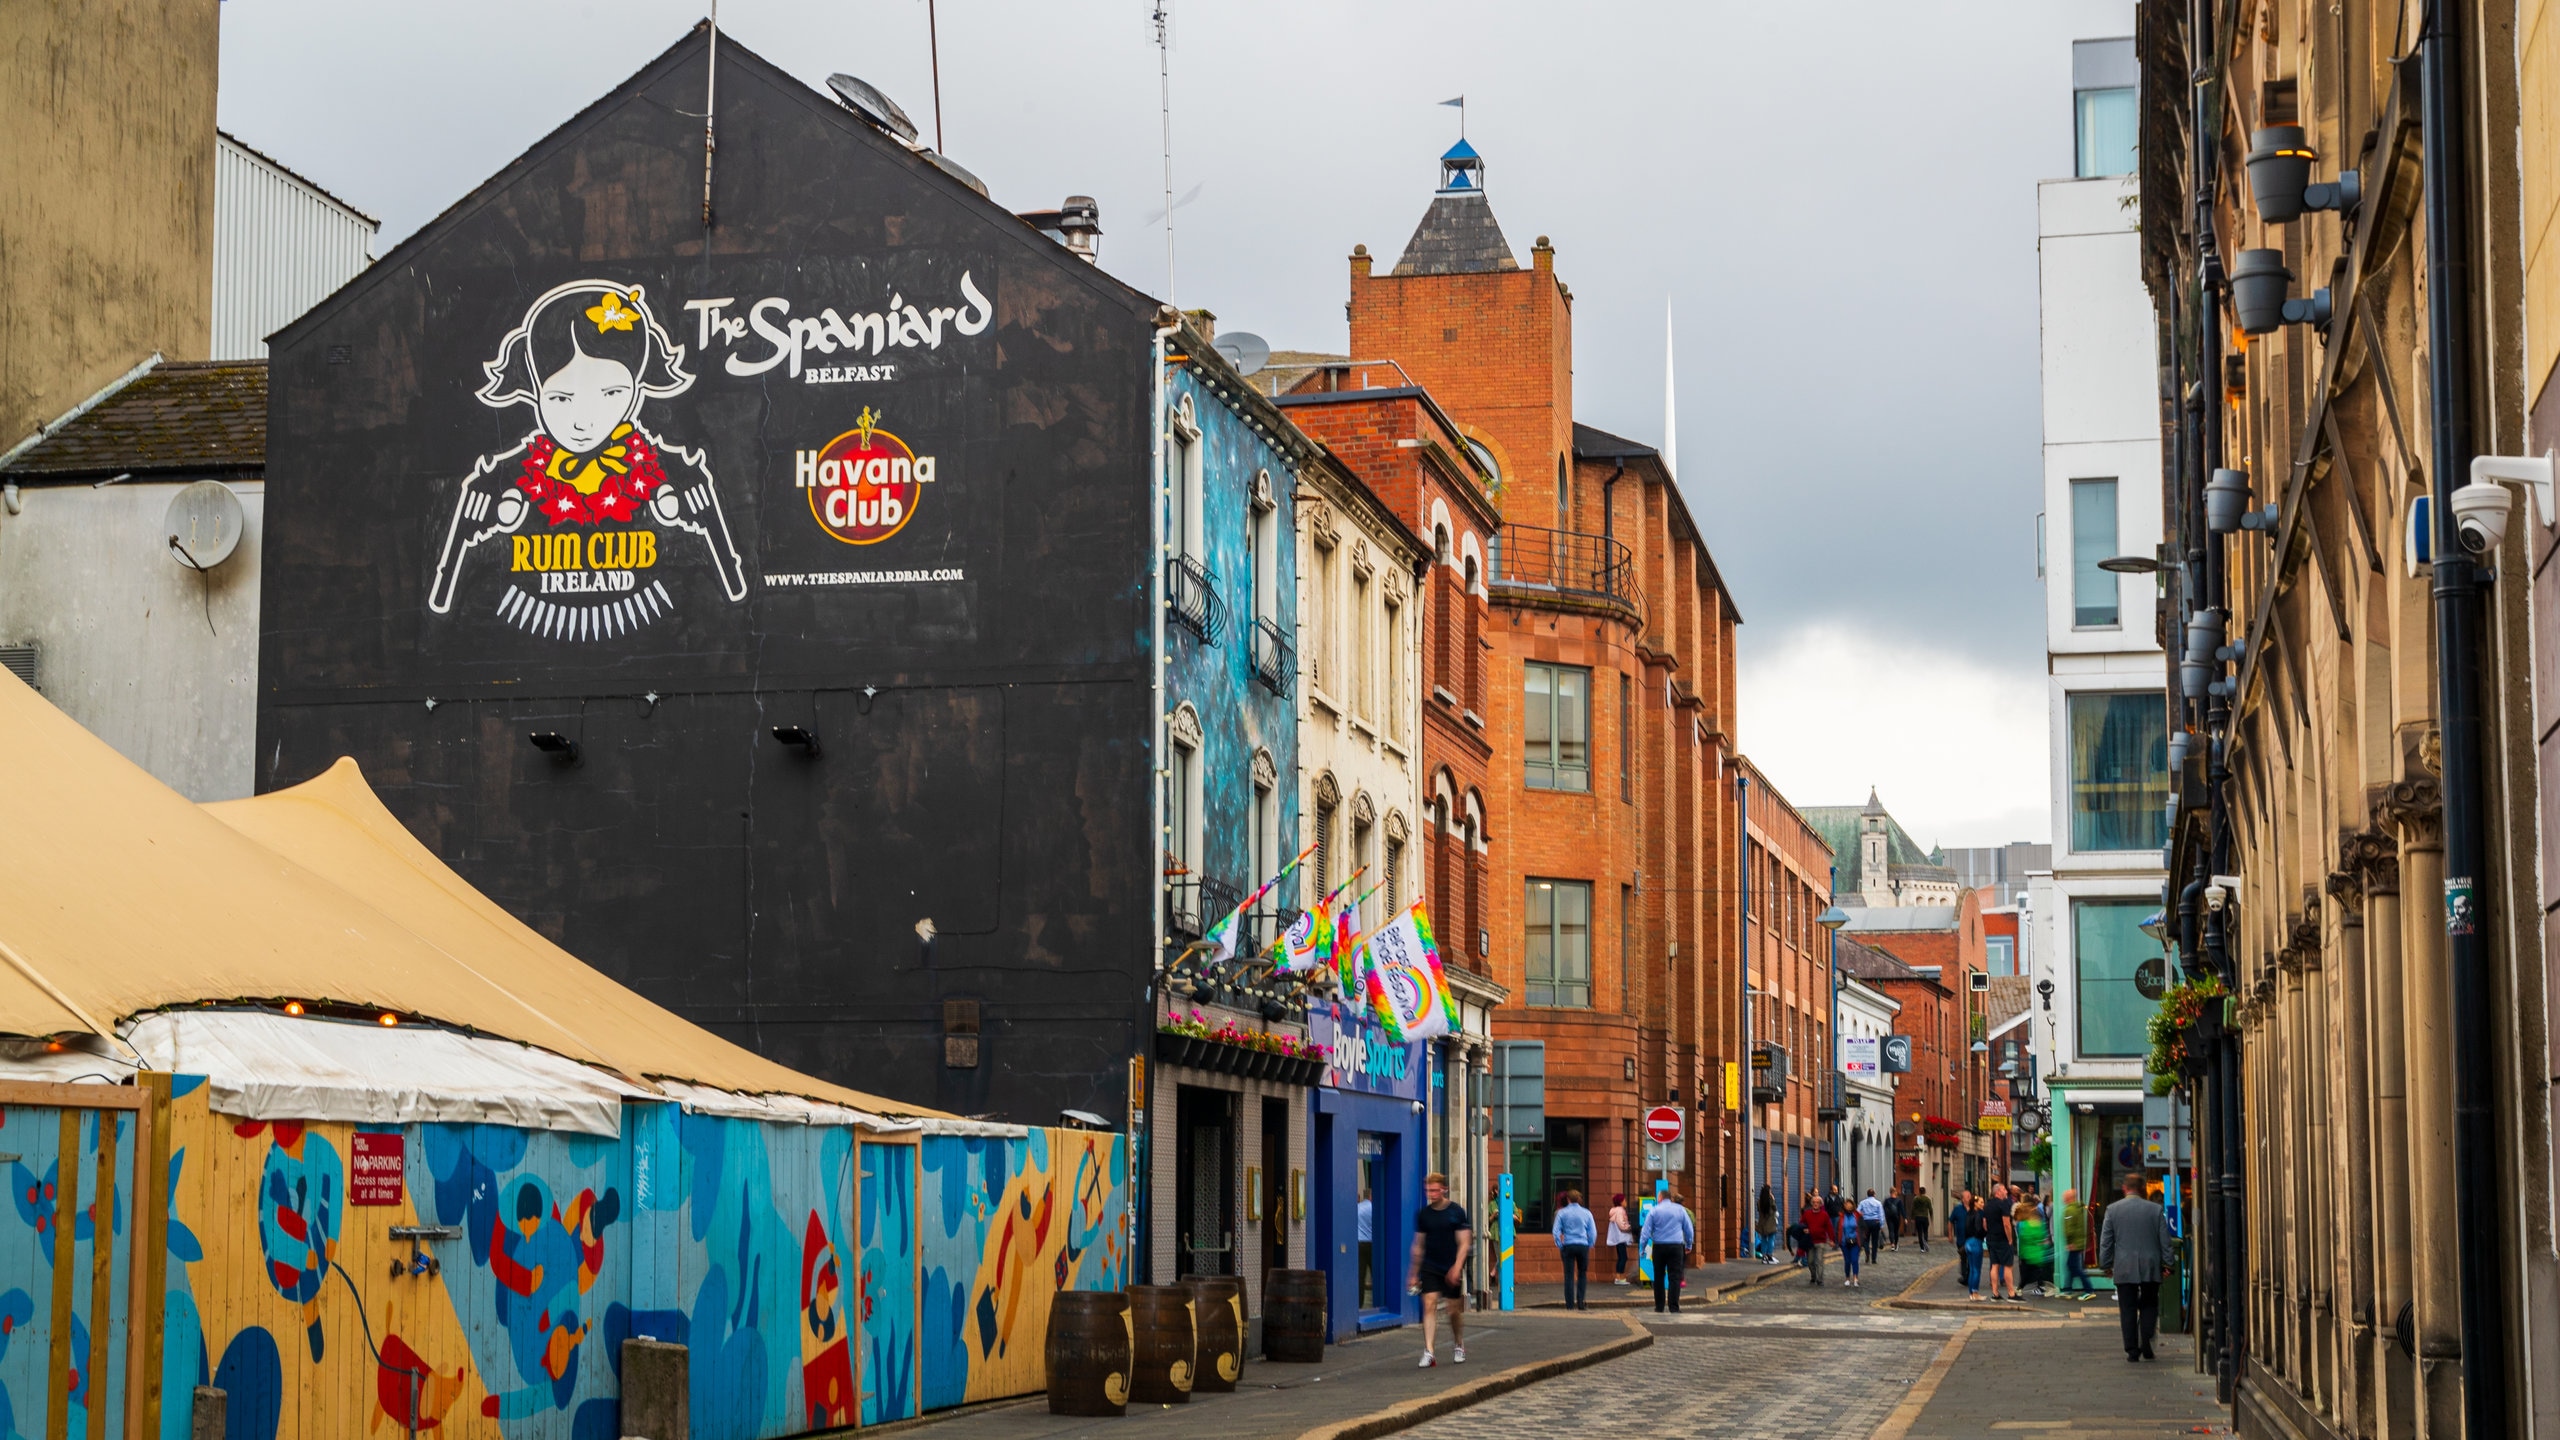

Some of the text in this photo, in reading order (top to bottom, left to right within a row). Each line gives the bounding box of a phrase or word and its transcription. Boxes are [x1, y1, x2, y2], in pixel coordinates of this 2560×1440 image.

[684, 269, 992, 379] The Spaniard
[805, 364, 896, 384] BELFAST
[796, 448, 936, 491] Havana
[825, 489, 903, 530] Club
[511, 530, 657, 572] RUM CLUB
[540, 570, 635, 594] IRELAND
[764, 567, 964, 588] WWW.THESPANIARDBAR.COM
[1333, 1021, 1406, 1087] BoyleSports
[369, 1156, 401, 1170] PARKING
[354, 1174, 401, 1187] Access required
[361, 1188, 367, 1198] at
[378, 1188, 393, 1199] times
